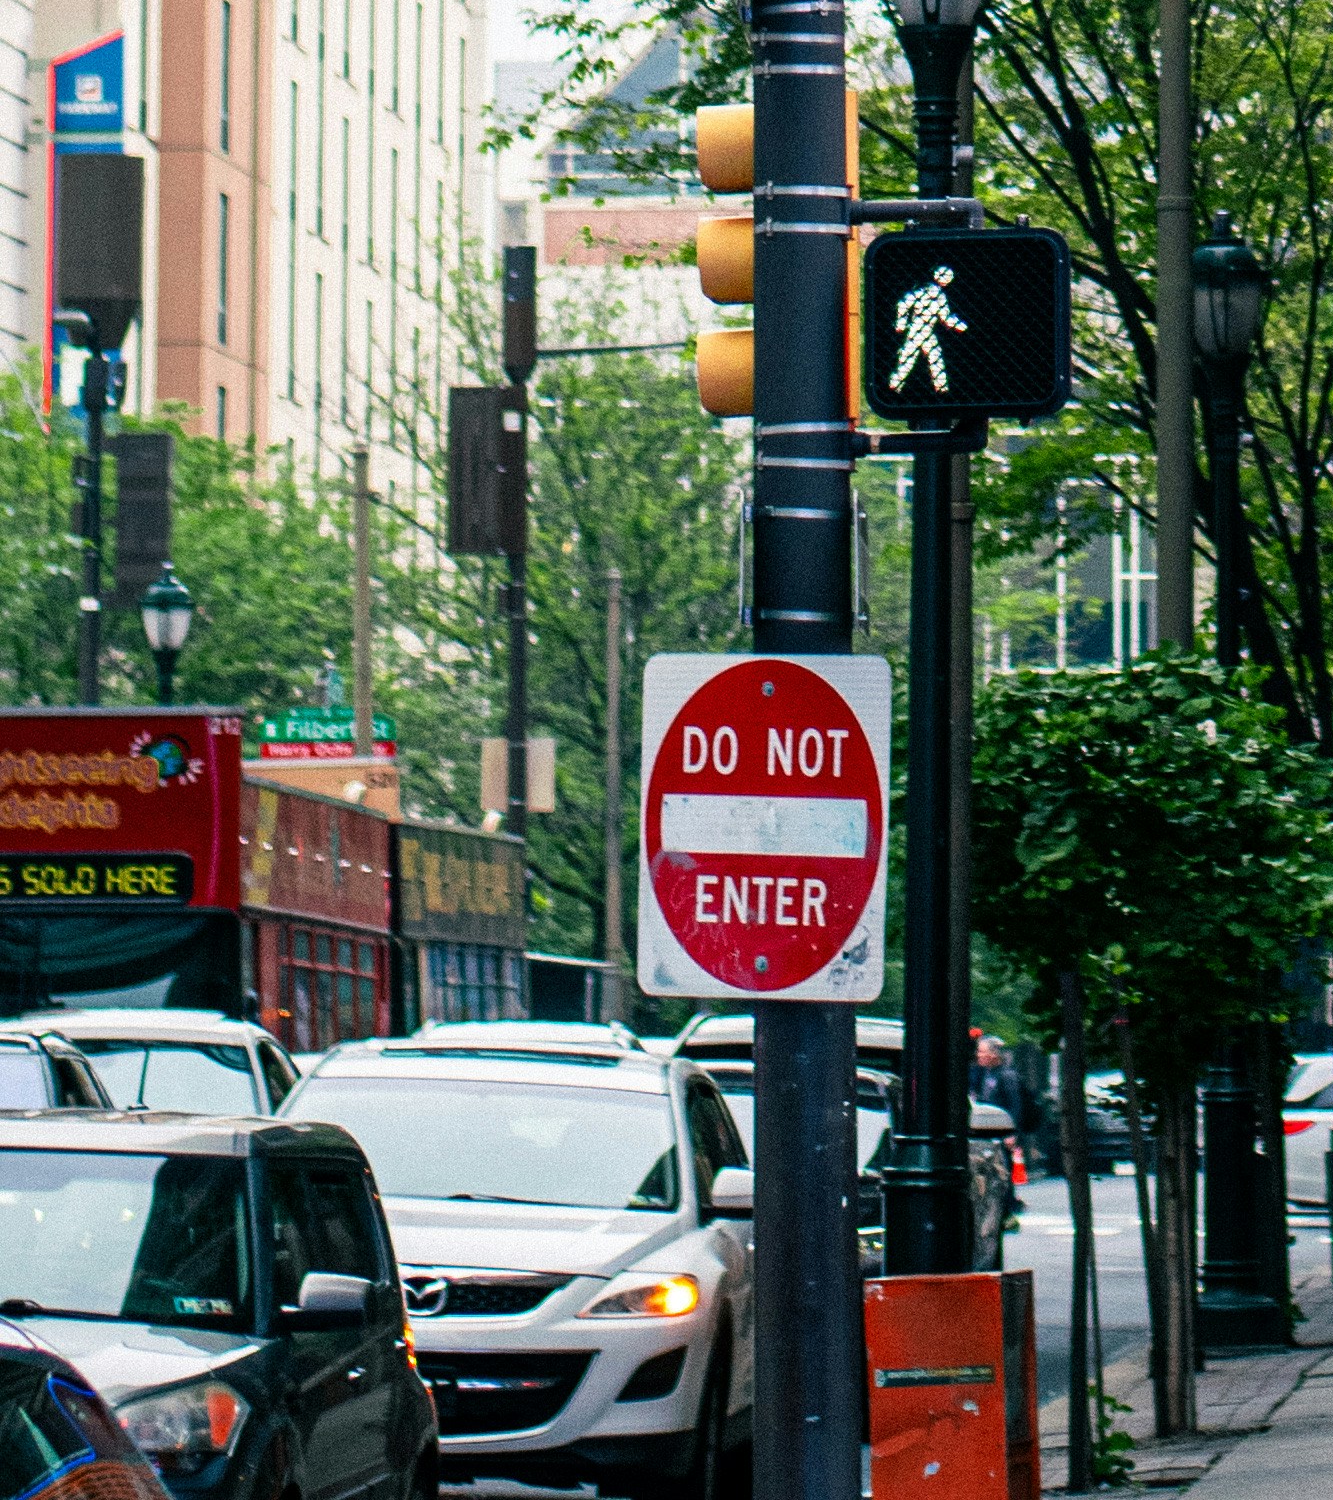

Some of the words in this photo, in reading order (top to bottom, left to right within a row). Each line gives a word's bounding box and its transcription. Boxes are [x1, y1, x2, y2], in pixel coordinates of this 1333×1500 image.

[683, 726, 738, 775] DO
[768, 728, 849, 777] NOT
[22, 866, 96, 894] SOLD
[105, 866, 177, 894] HERE
[696, 875, 827, 926] ENTER
